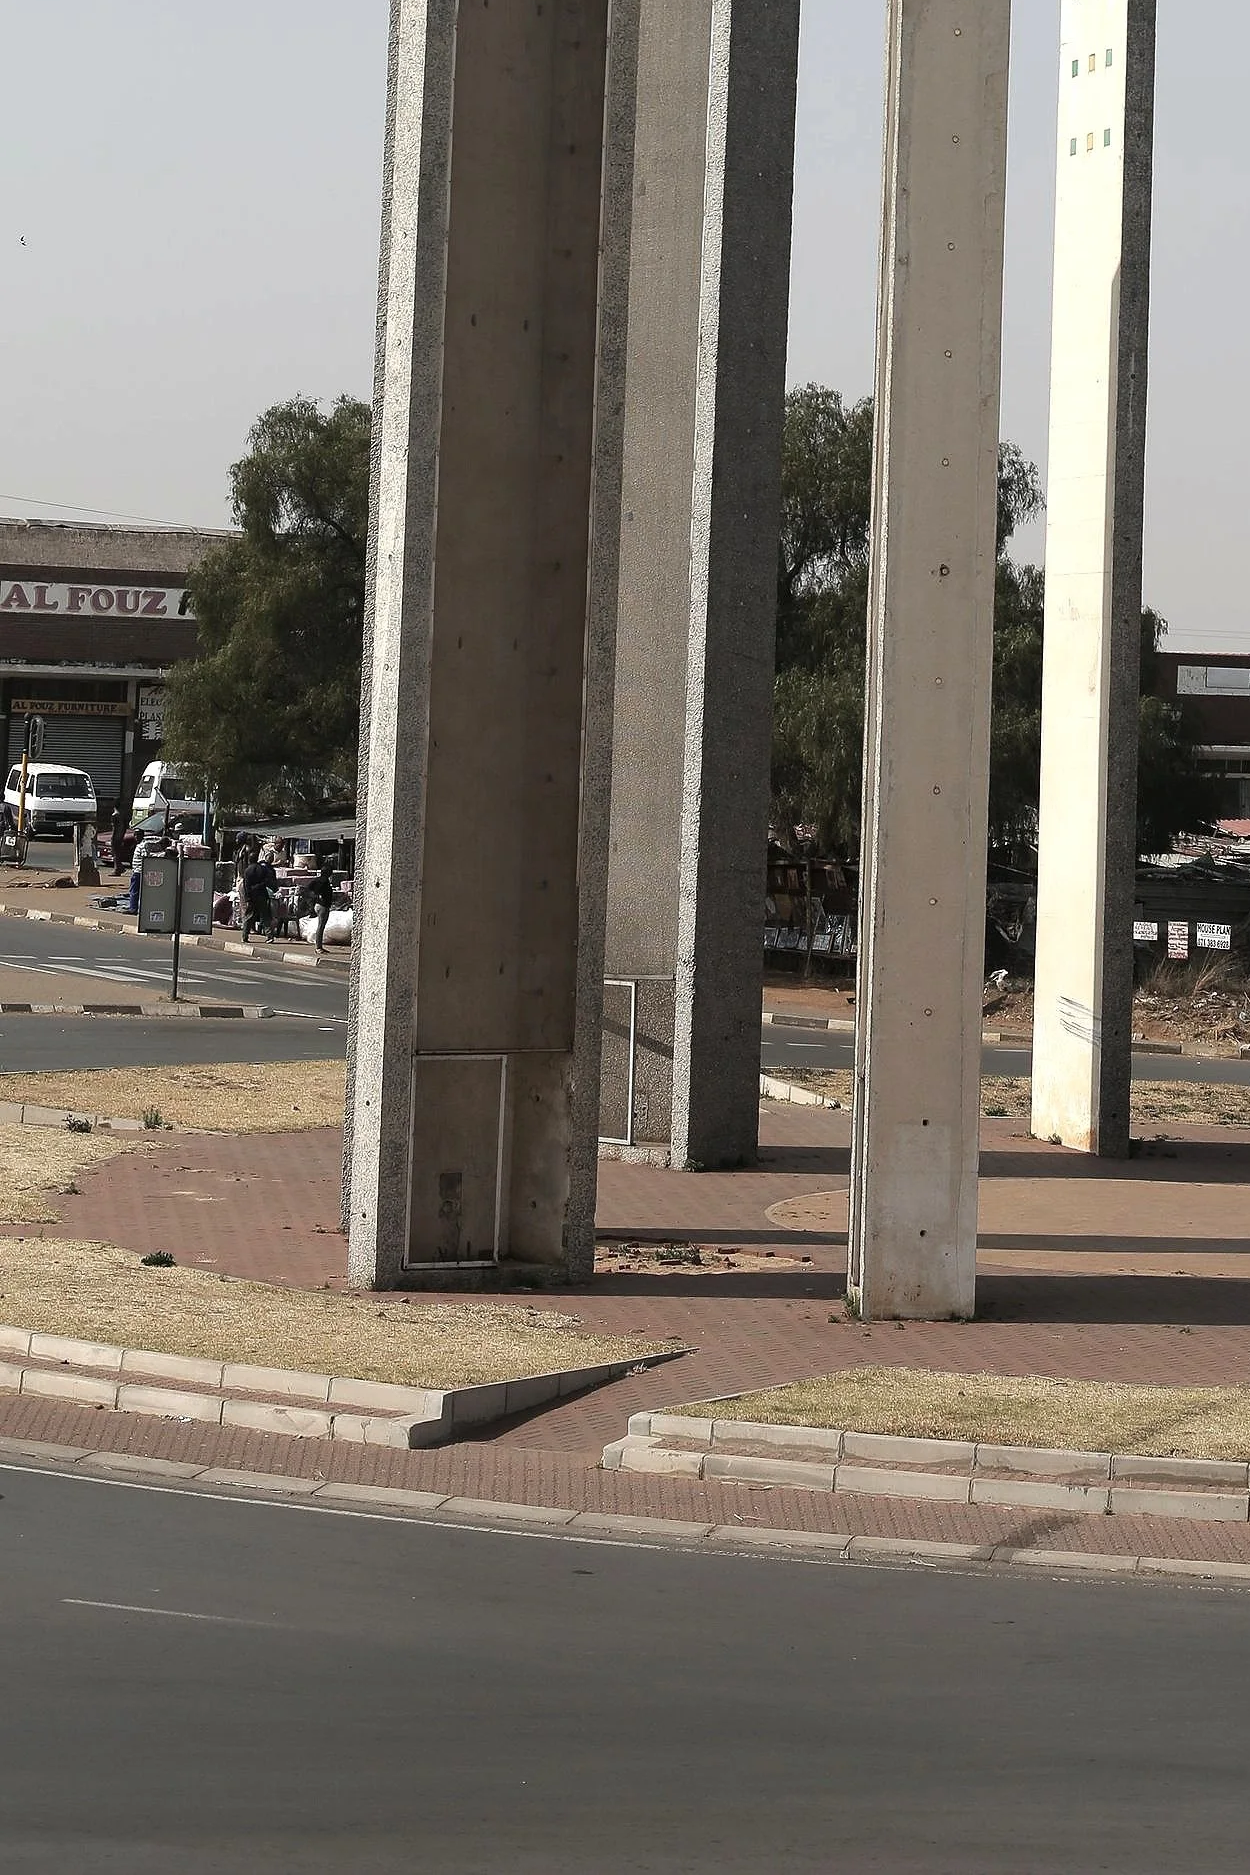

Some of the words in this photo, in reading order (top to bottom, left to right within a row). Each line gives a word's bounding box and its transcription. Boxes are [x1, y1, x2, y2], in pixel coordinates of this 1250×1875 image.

[0, 583, 58, 611] AL
[67, 586, 168, 616] FOUZ
[13, 701, 27, 710] AL
[30, 701, 55, 711] FOUZ
[58, 702, 118, 713] FURNITURE
